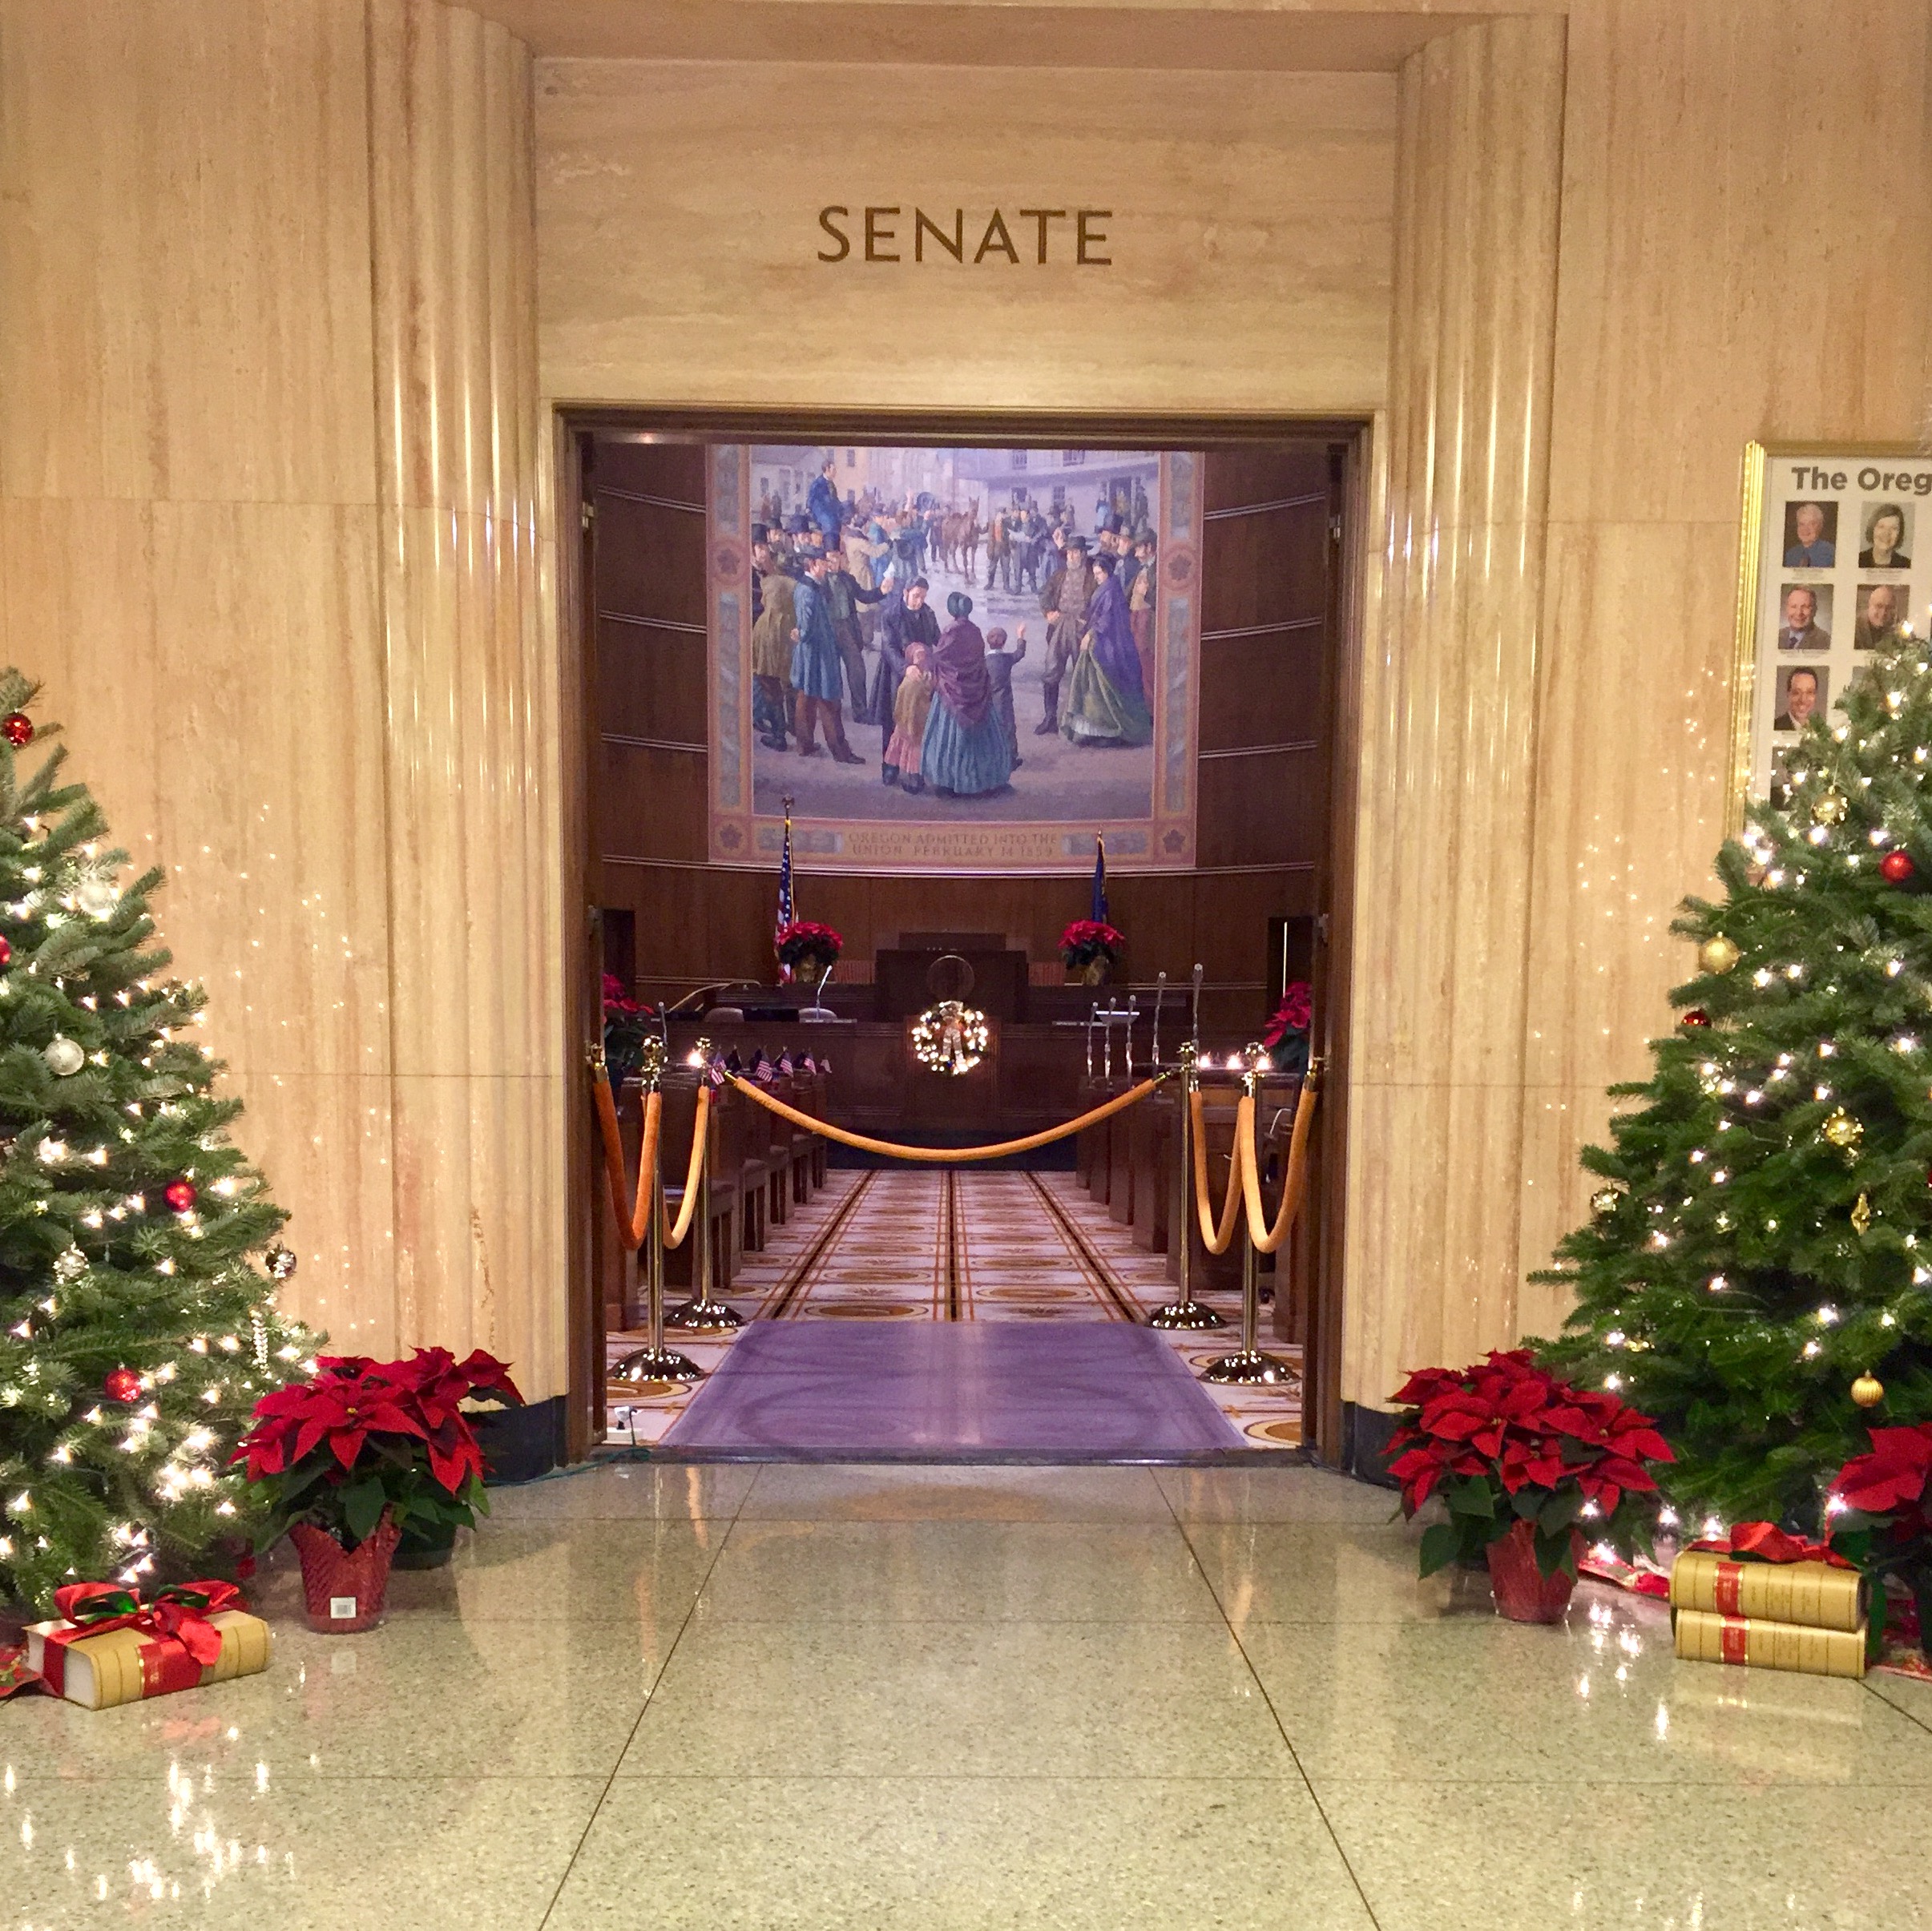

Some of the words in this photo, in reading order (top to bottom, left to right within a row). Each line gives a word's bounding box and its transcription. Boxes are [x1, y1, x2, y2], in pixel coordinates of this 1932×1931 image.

[817, 205, 1113, 265] SENATE
[1791, 466, 1848, 490] The
[1857, 466, 1932, 496] Oreg
[849, 832, 911, 844] OREGON
[916, 832, 990, 845] ADMITTED
[1031, 833, 1057, 845] THE
[852, 844, 902, 856] UNION
[914, 845, 994, 857] FEBRUARY
